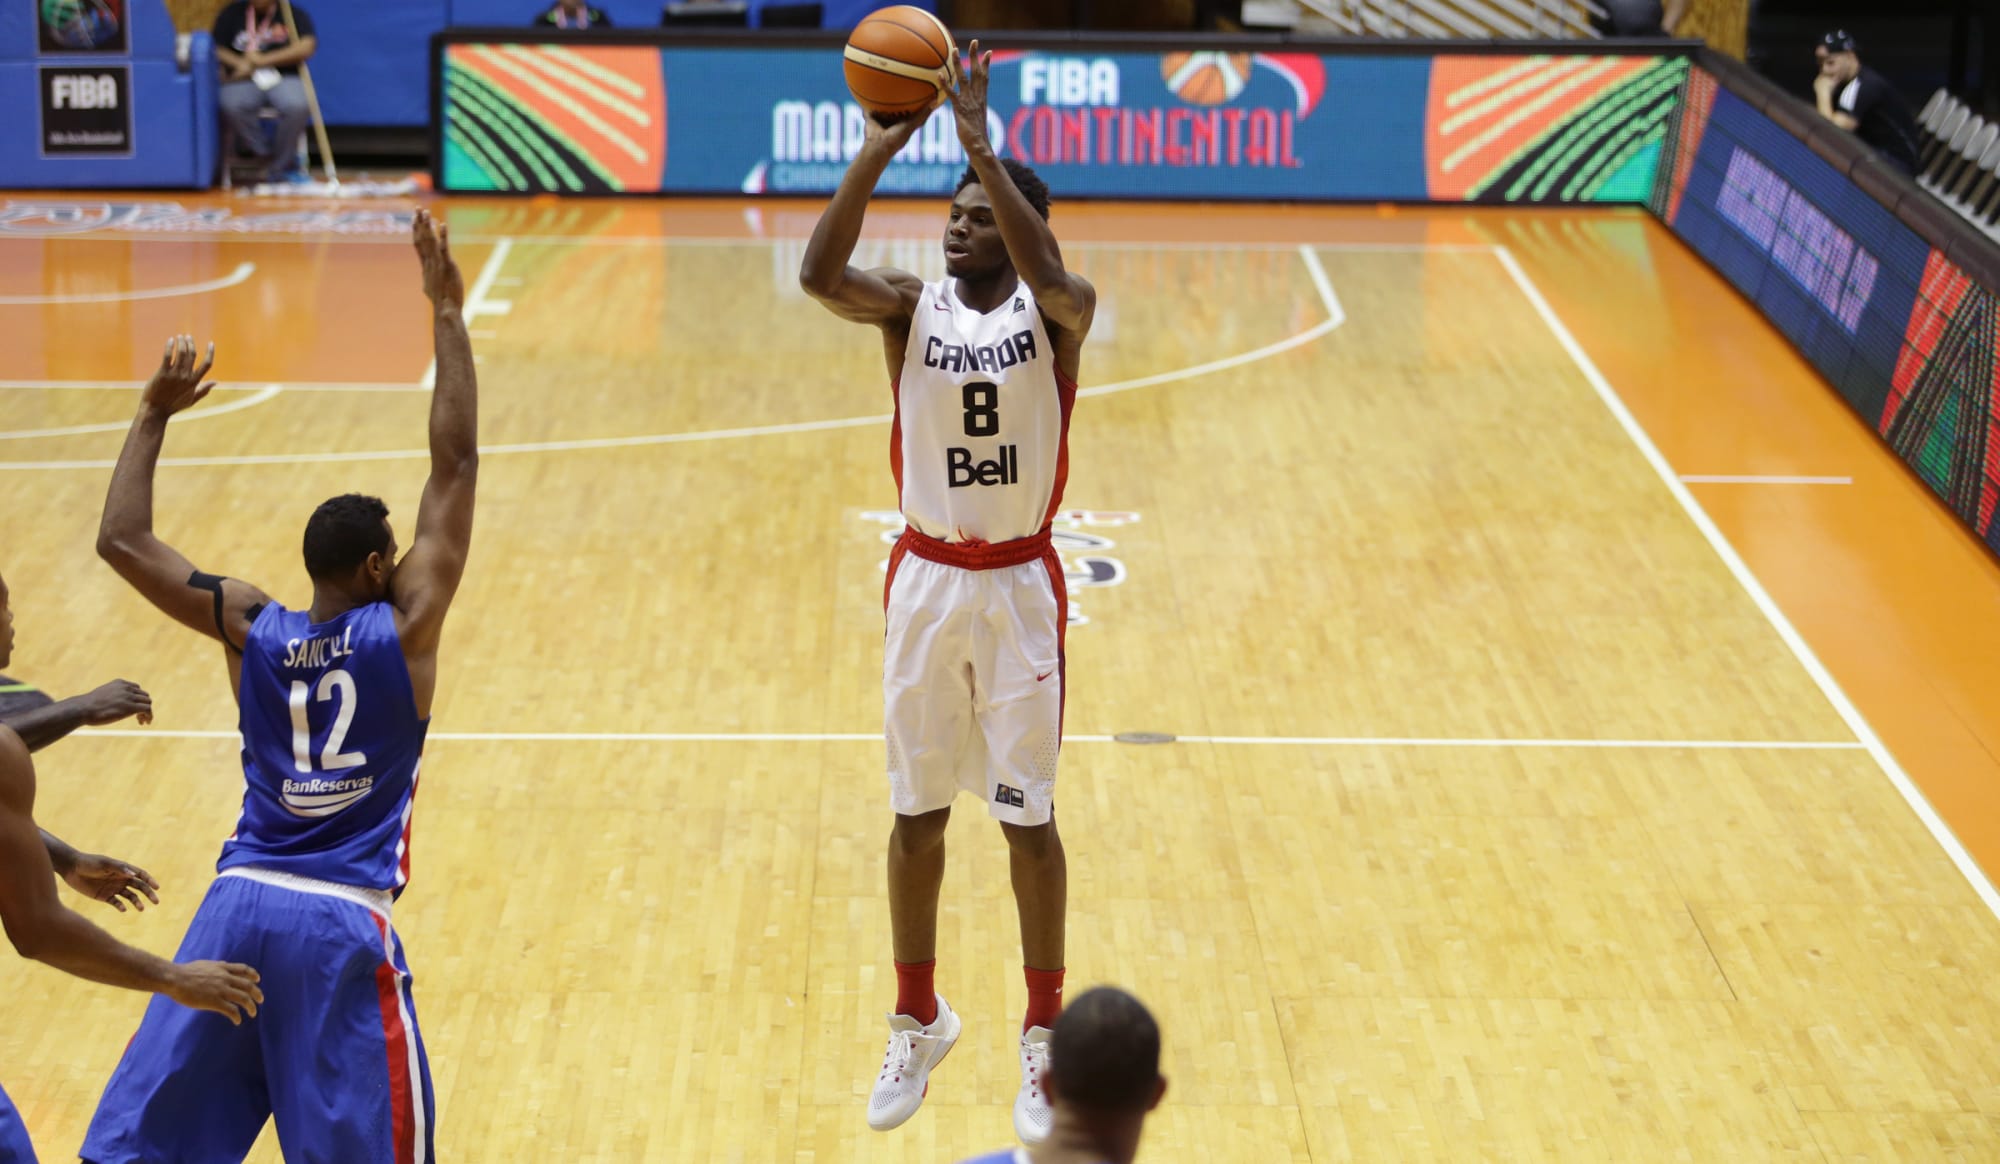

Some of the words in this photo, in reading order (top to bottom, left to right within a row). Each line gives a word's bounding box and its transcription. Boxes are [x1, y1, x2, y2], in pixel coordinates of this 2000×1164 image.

[52, 74, 118, 109] FIBA
[1020, 58, 1119, 105] FIBA
[1008, 104, 1303, 168] CONTINENTAL
[924, 329, 1037, 374] CANADA
[962, 381, 999, 437] 8
[946, 444, 1018, 488] Bell
[289, 669, 367, 773] 12
[282, 775, 374, 794] BanReservas
